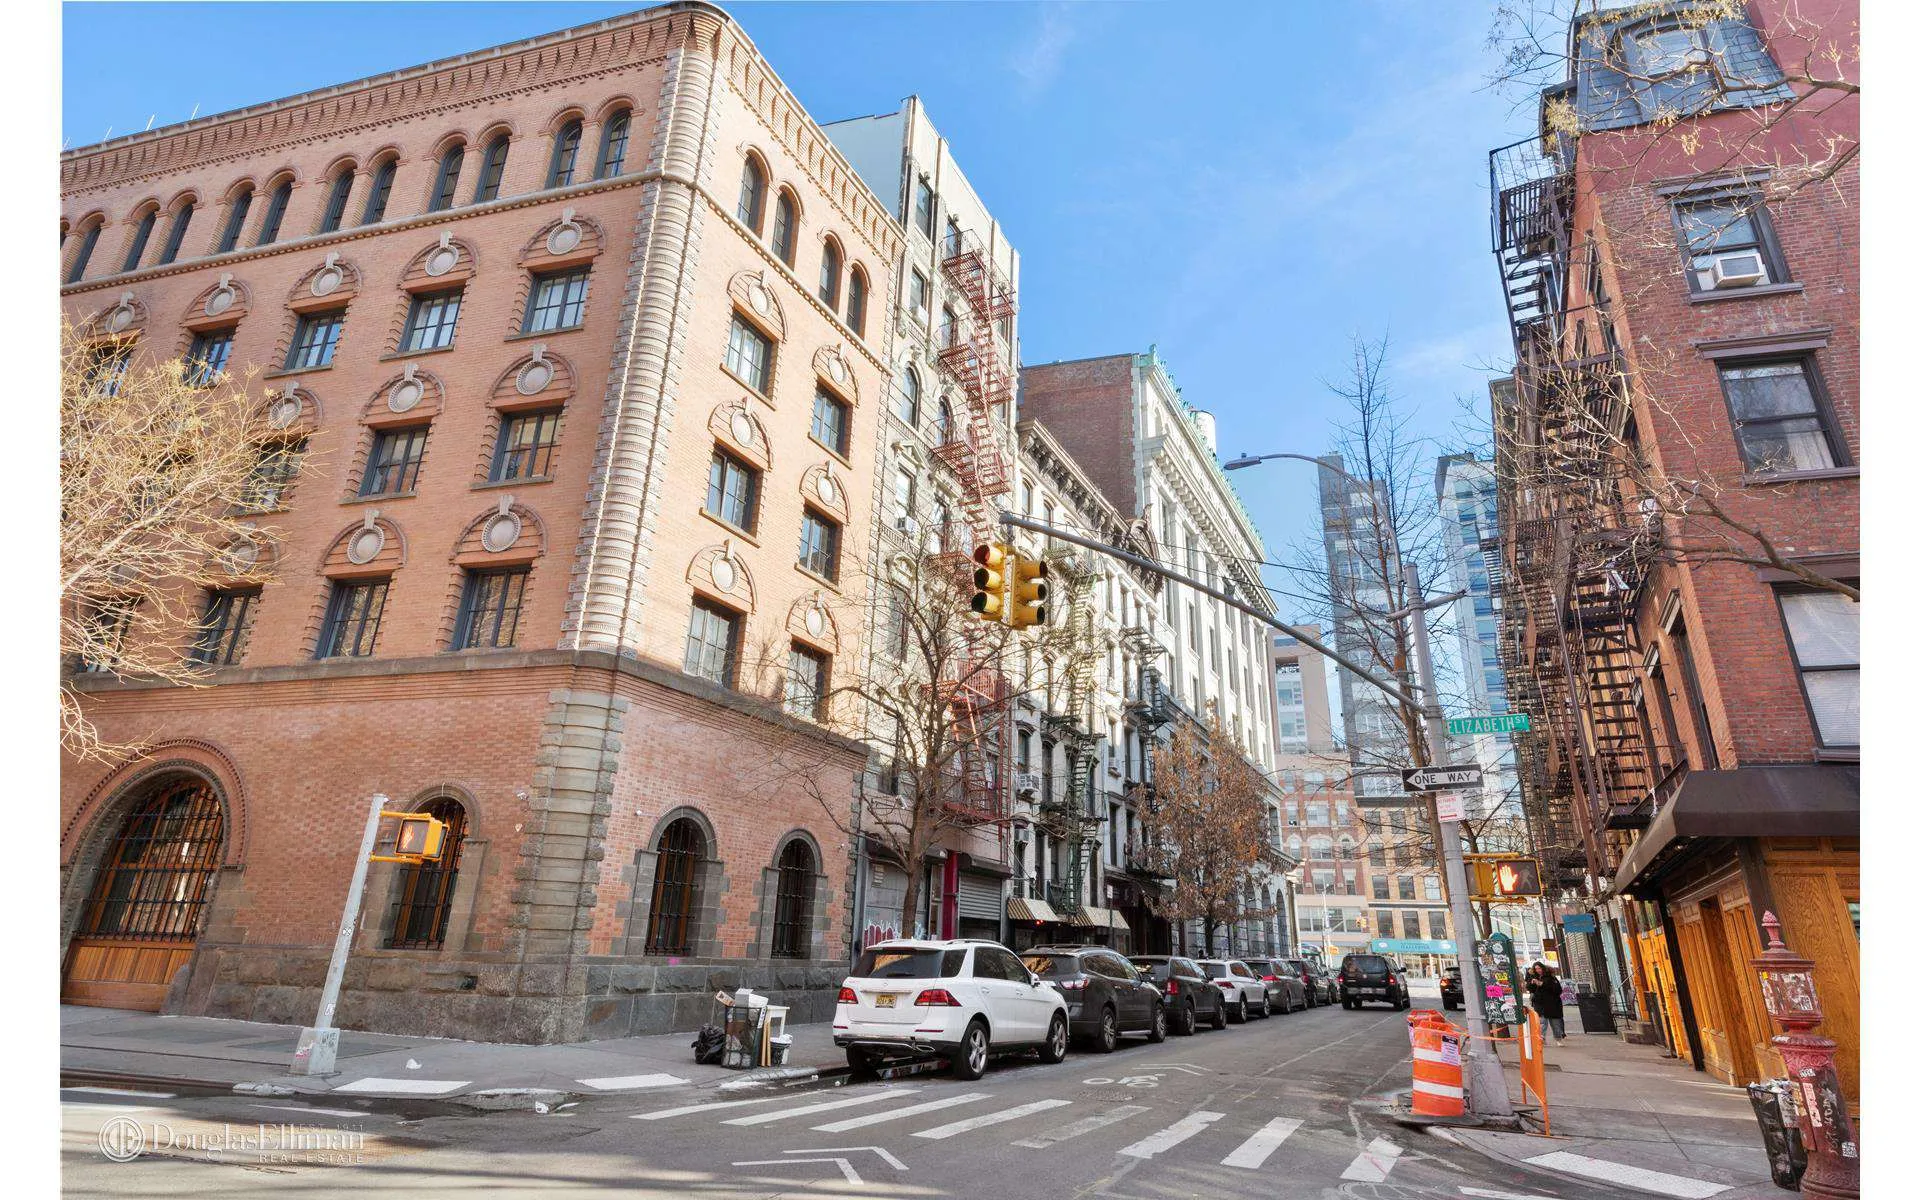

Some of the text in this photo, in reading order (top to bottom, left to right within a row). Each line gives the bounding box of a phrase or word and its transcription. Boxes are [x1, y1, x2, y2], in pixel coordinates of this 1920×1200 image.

[1447, 715, 1526, 735] ELIZABETH ST
[1414, 772, 1471, 785] ONE WAY
